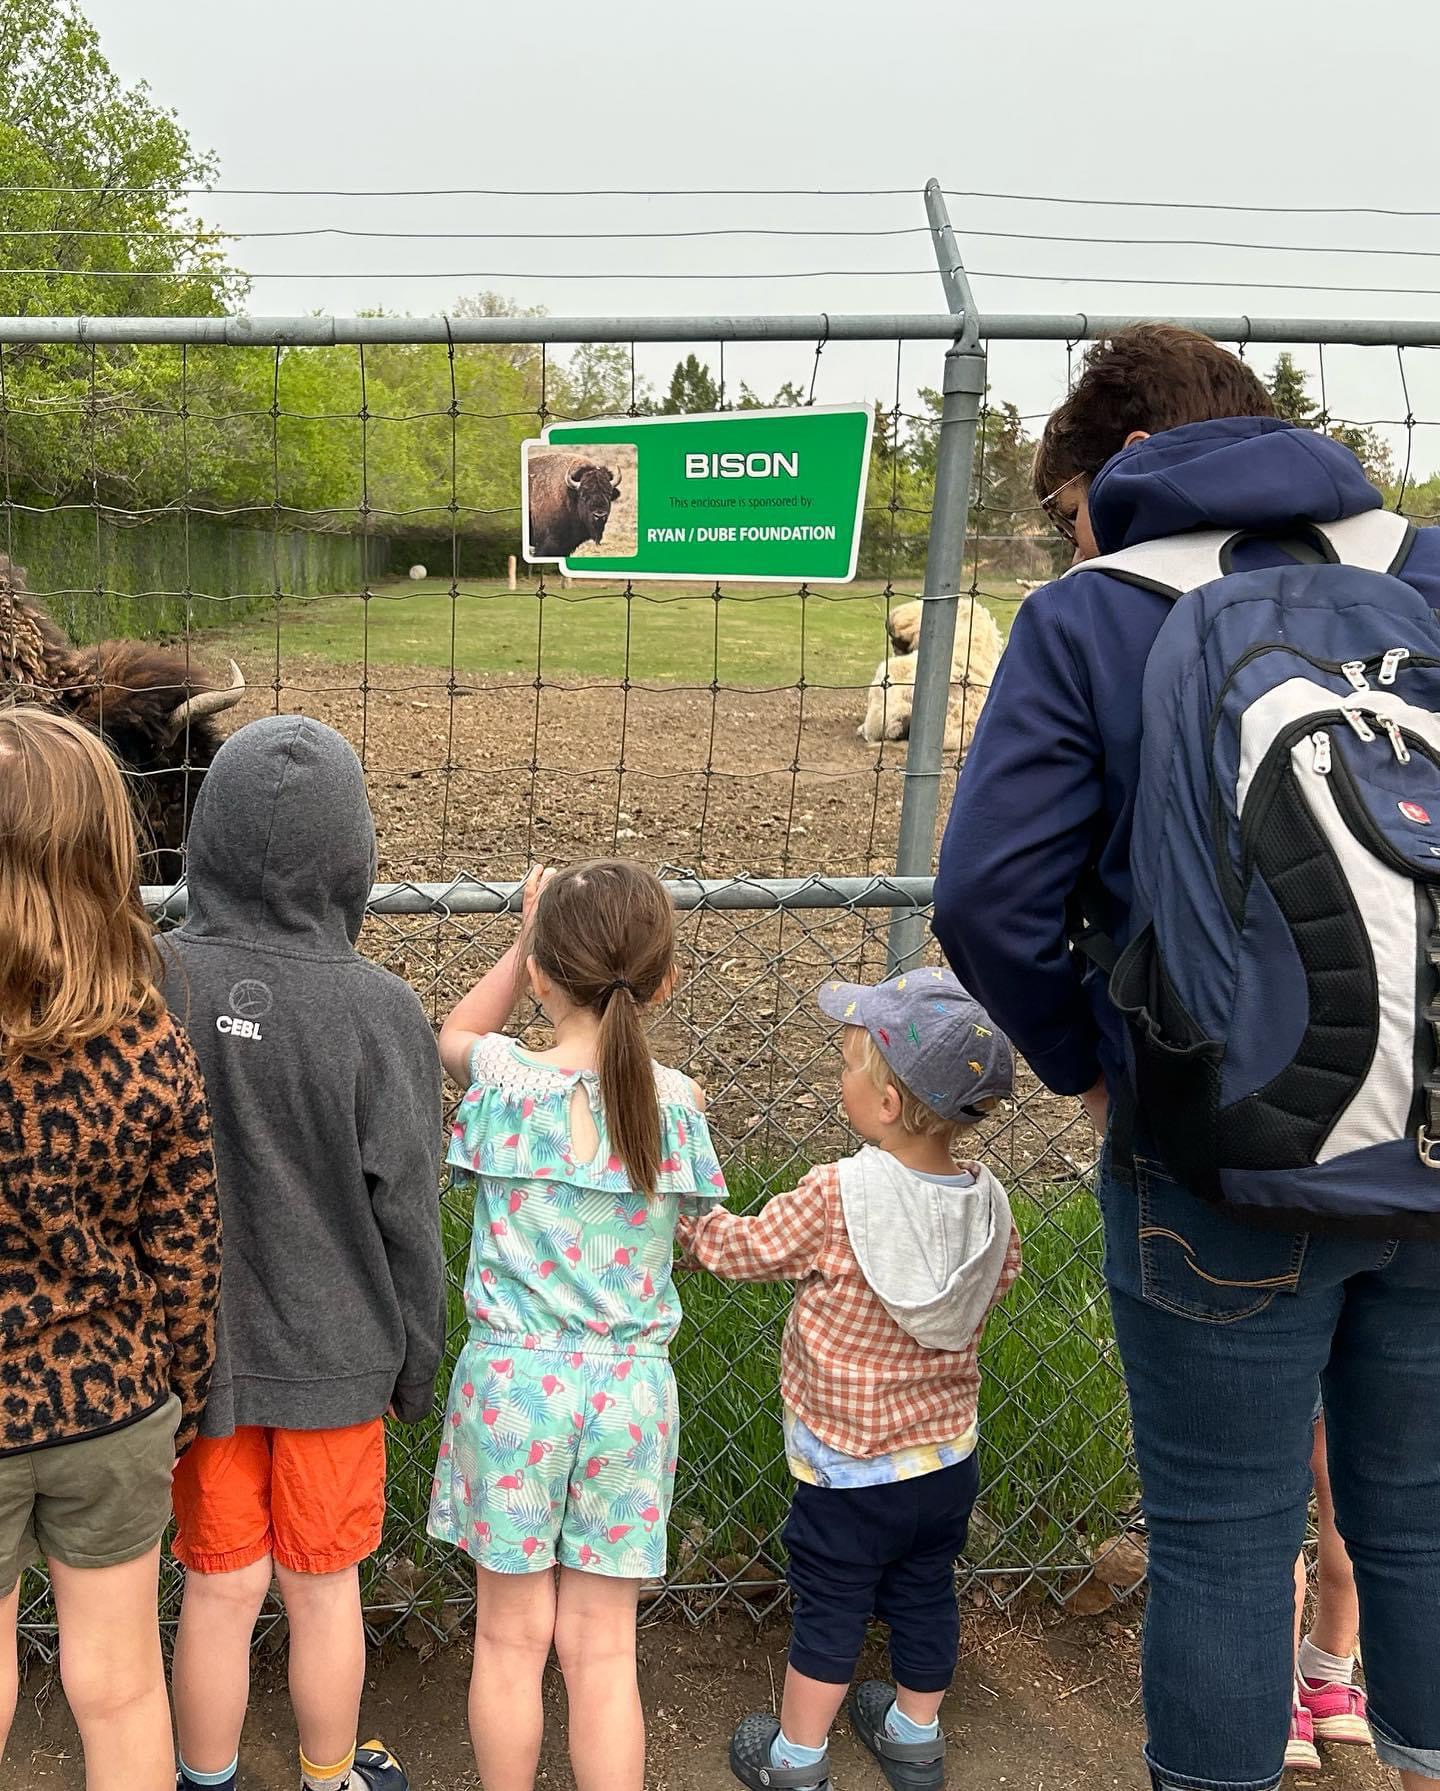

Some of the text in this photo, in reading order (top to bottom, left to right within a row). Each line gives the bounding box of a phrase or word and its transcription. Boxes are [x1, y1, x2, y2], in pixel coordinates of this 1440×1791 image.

[685, 452, 799, 479] BISON
[669, 497, 688, 508] This
[691, 497, 736, 508] enclosure
[738, 497, 746, 508] is
[749, 496, 797, 510] sponsored
[647, 526, 836, 543] RYAN / DUBE FOUNDATION
[216, 1015, 263, 1041] CEBL
